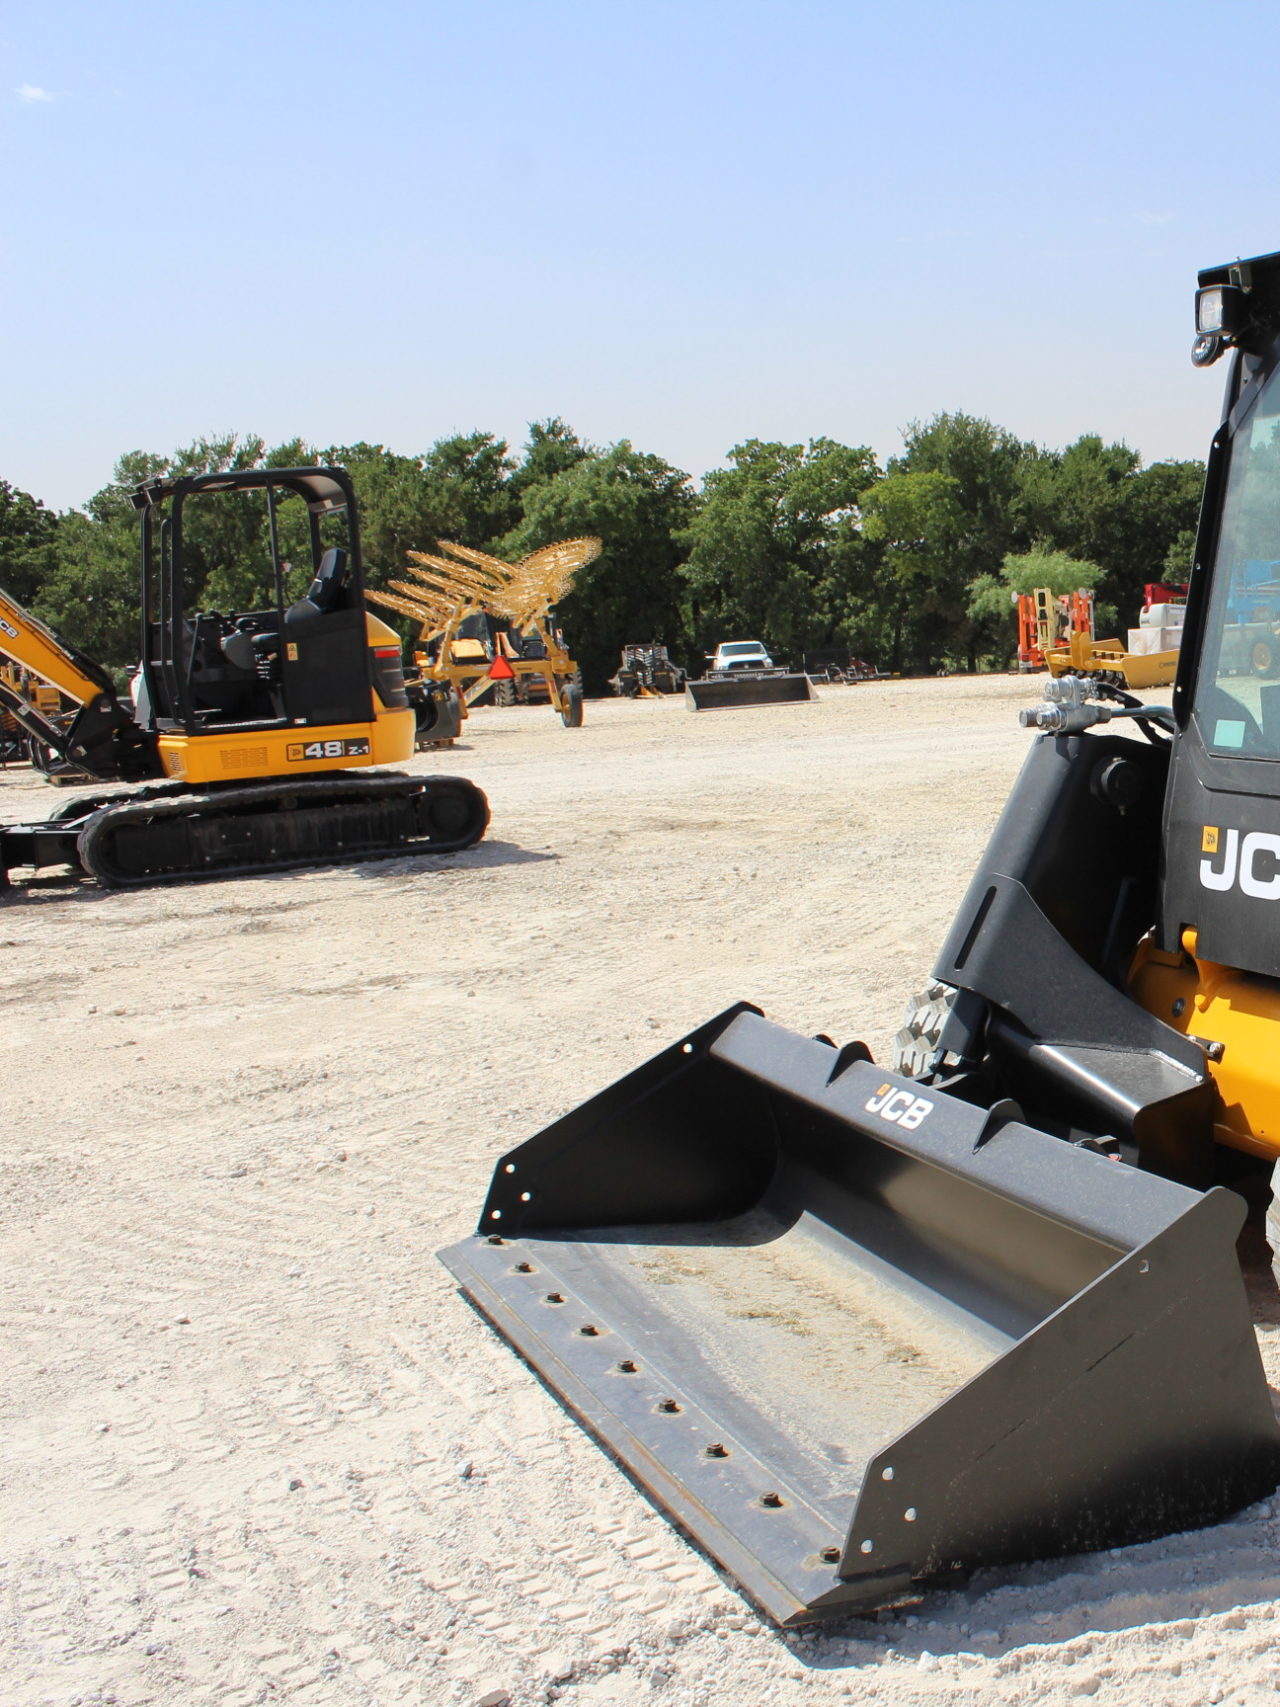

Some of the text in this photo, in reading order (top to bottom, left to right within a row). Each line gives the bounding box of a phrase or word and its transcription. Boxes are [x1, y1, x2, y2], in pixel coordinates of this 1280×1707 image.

[0, 617, 18, 638] CB
[305, 741, 370, 758] 48 Z-1
[864, 1086, 935, 1130] JCB
